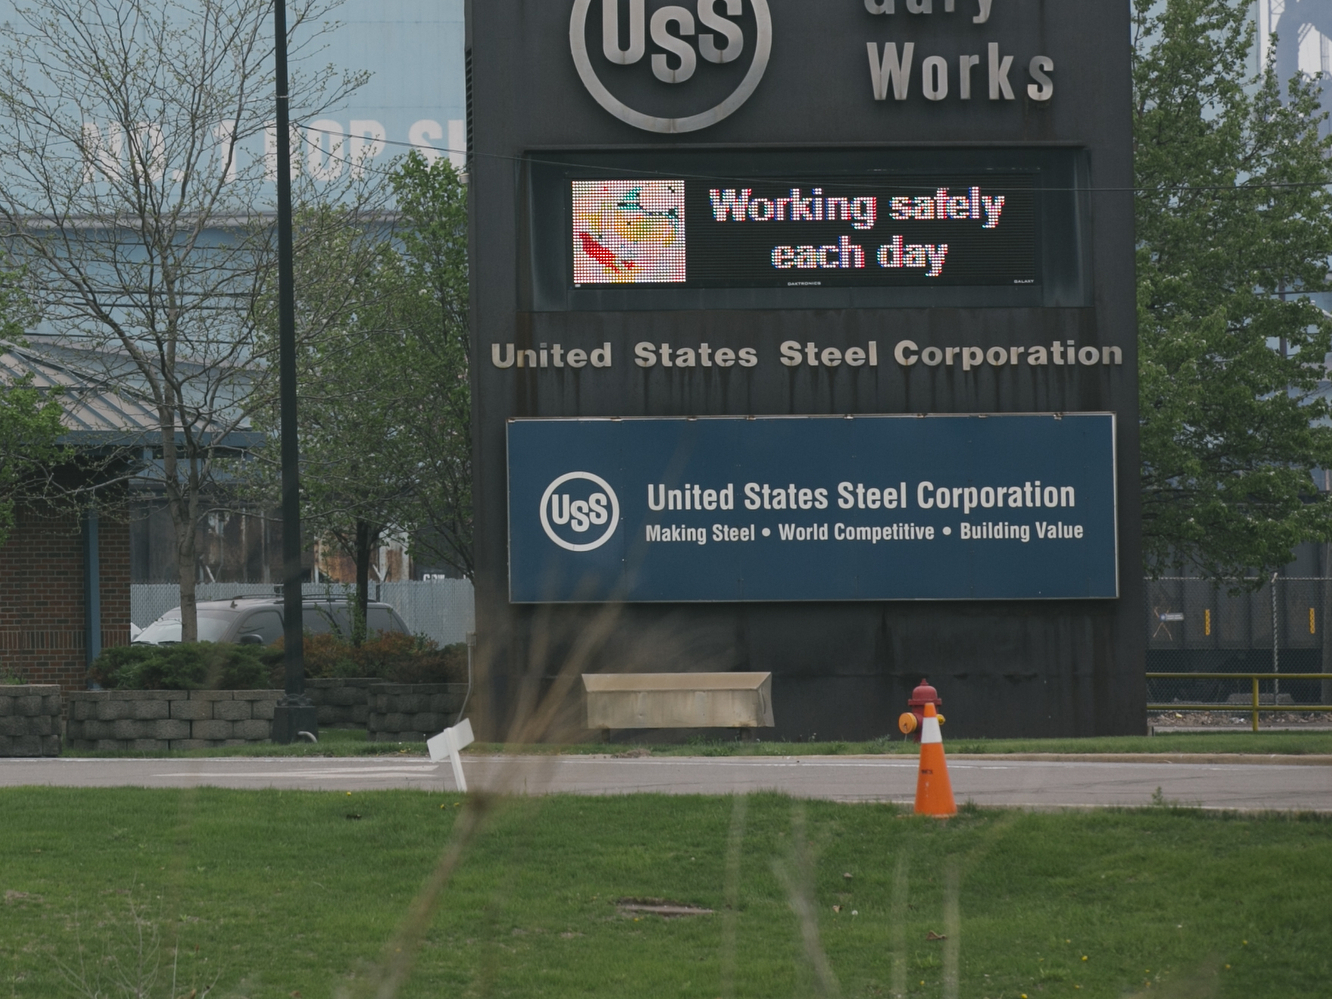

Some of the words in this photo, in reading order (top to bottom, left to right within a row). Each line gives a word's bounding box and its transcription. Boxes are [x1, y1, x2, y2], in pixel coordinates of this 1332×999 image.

[866, 41, 1055, 101] Works
[709, 188, 876, 230] Working
[889, 186, 1005, 228] safely
[771, 236, 865, 269] each
[877, 235, 948, 277] day
[490, 341, 612, 369] United
[634, 341, 758, 368] States
[779, 339, 878, 367] Steel
[893, 339, 1123, 371] Corporation
[647, 482, 734, 511] United
[744, 482, 829, 510] States
[837, 481, 907, 509] Steel
[916, 480, 1076, 514] Corporation
[645, 524, 707, 546] Making
[712, 523, 755, 542] Steel
[778, 522, 828, 541] World
[833, 522, 935, 545] Competitive
[960, 521, 1030, 543] Building
[1035, 521, 1084, 539] Value
